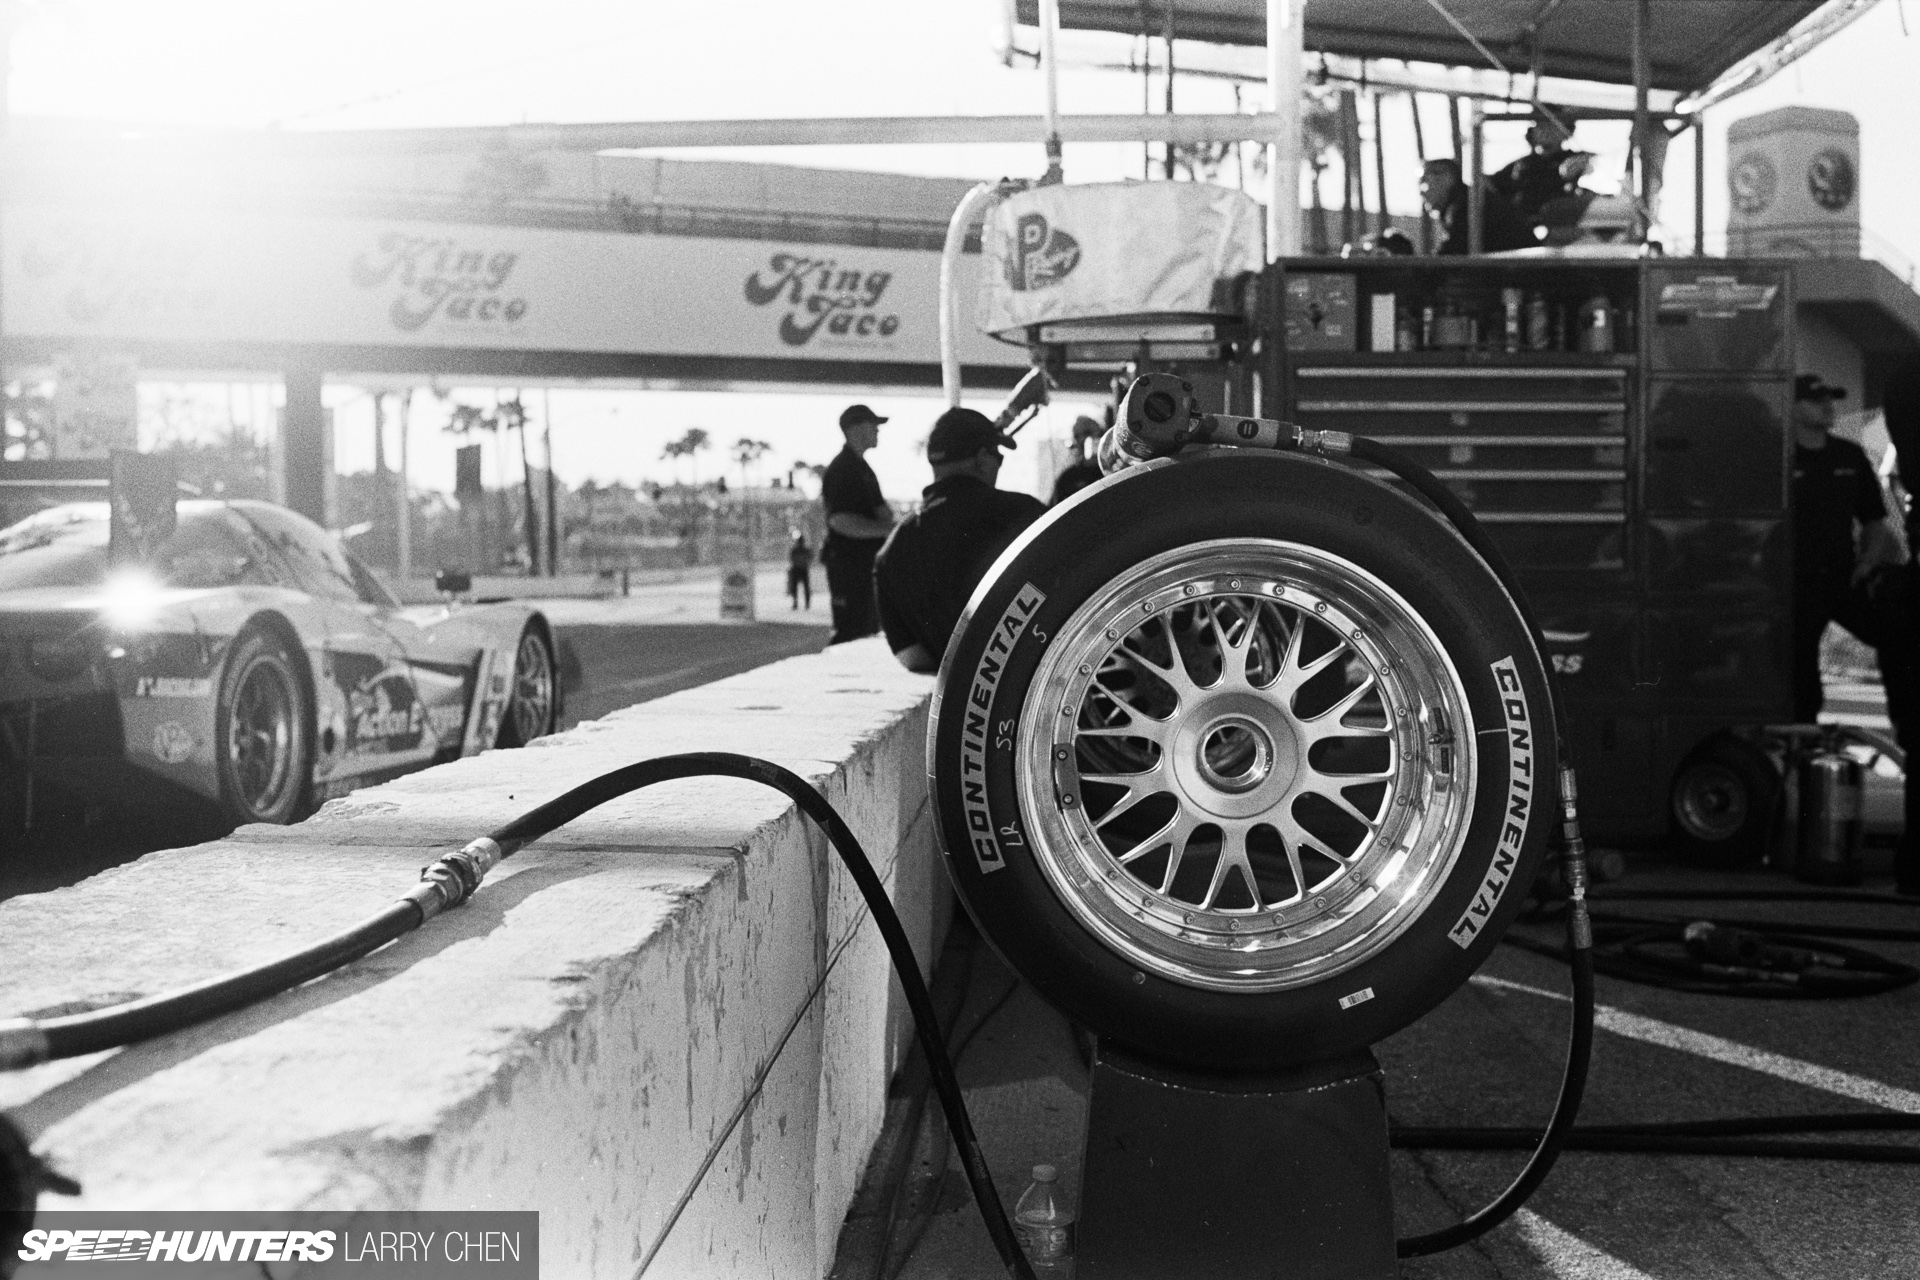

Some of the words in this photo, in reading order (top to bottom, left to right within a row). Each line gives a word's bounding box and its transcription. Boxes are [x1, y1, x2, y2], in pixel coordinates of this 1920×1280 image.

[350, 231, 519, 291] King
[744, 252, 893, 308] King
[389, 276, 528, 334] Taco
[778, 294, 900, 347] Taco
[962, 594, 1041, 864] CONTINENTAL
[1452, 665, 1532, 938] CONTINENTAL
